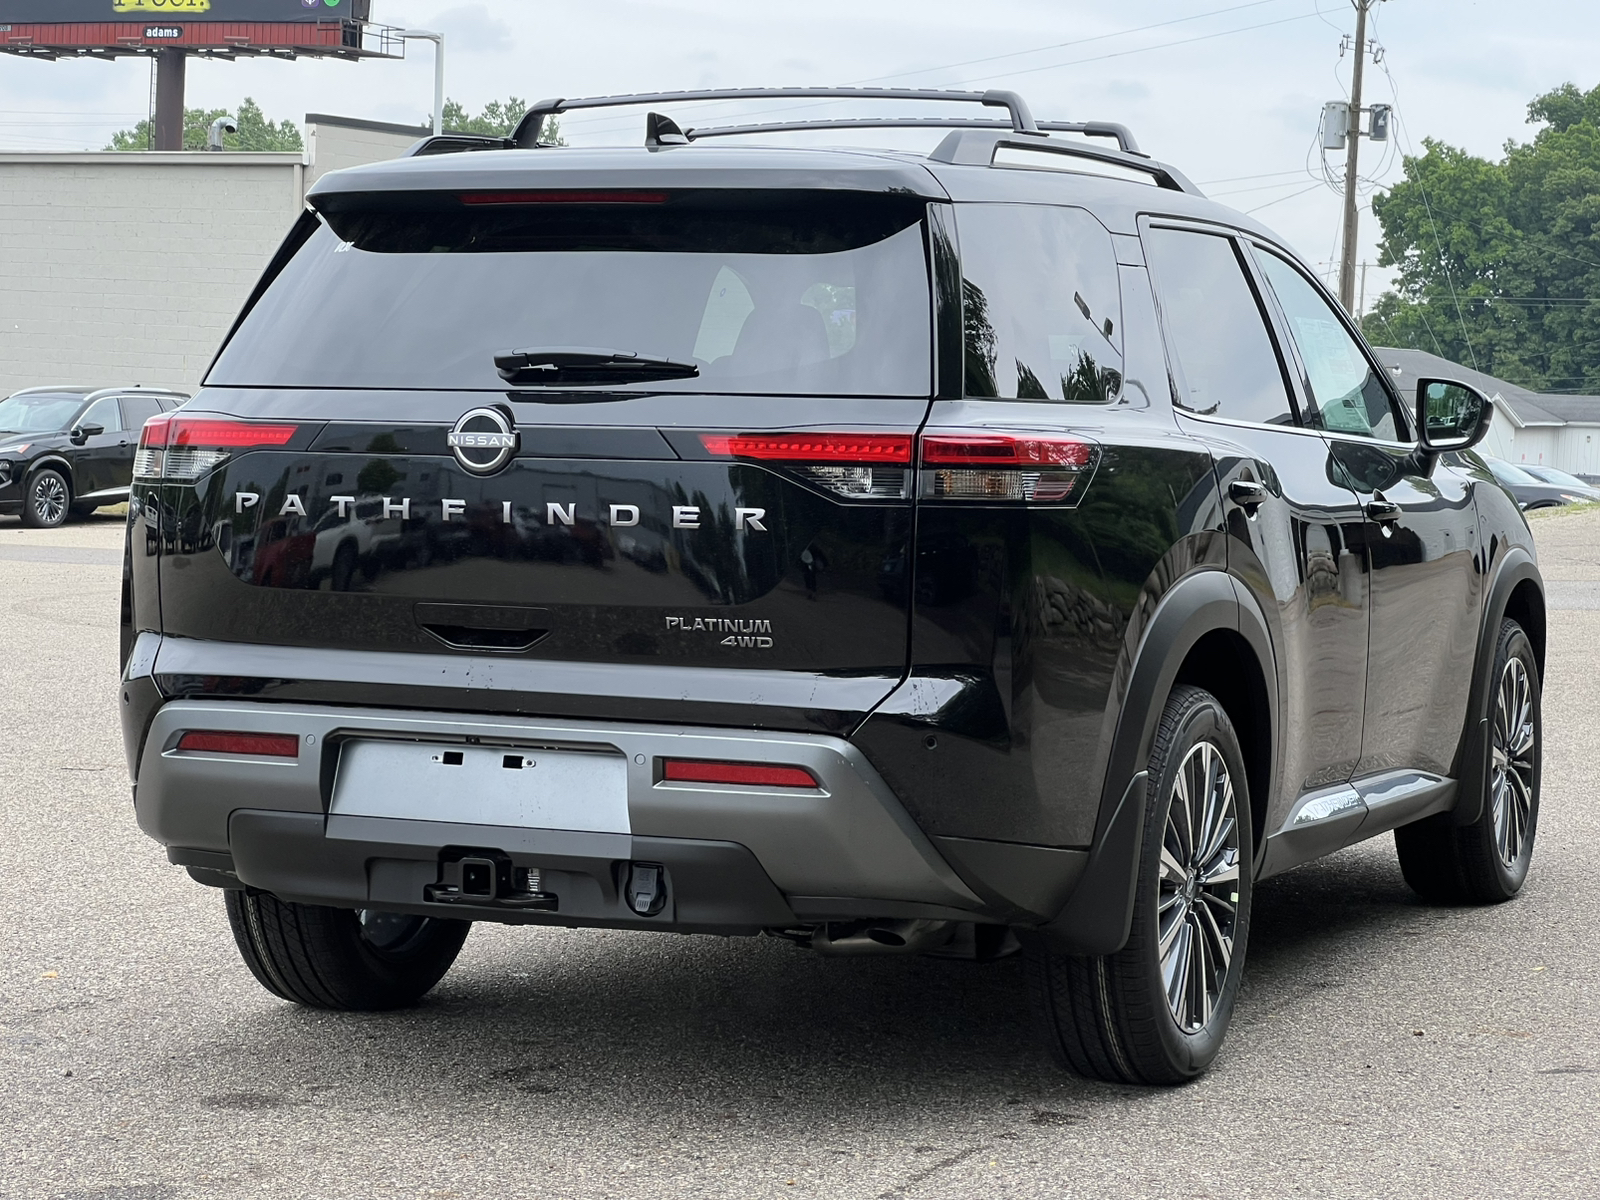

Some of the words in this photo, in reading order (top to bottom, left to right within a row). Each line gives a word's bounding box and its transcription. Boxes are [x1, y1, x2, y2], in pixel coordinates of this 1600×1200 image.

[145, 26, 179, 38] adams
[448, 435, 514, 447] NISSAN
[235, 491, 768, 532] PATHFINDER
[665, 616, 773, 634] PLATINUM
[720, 635, 774, 649] 4WD
